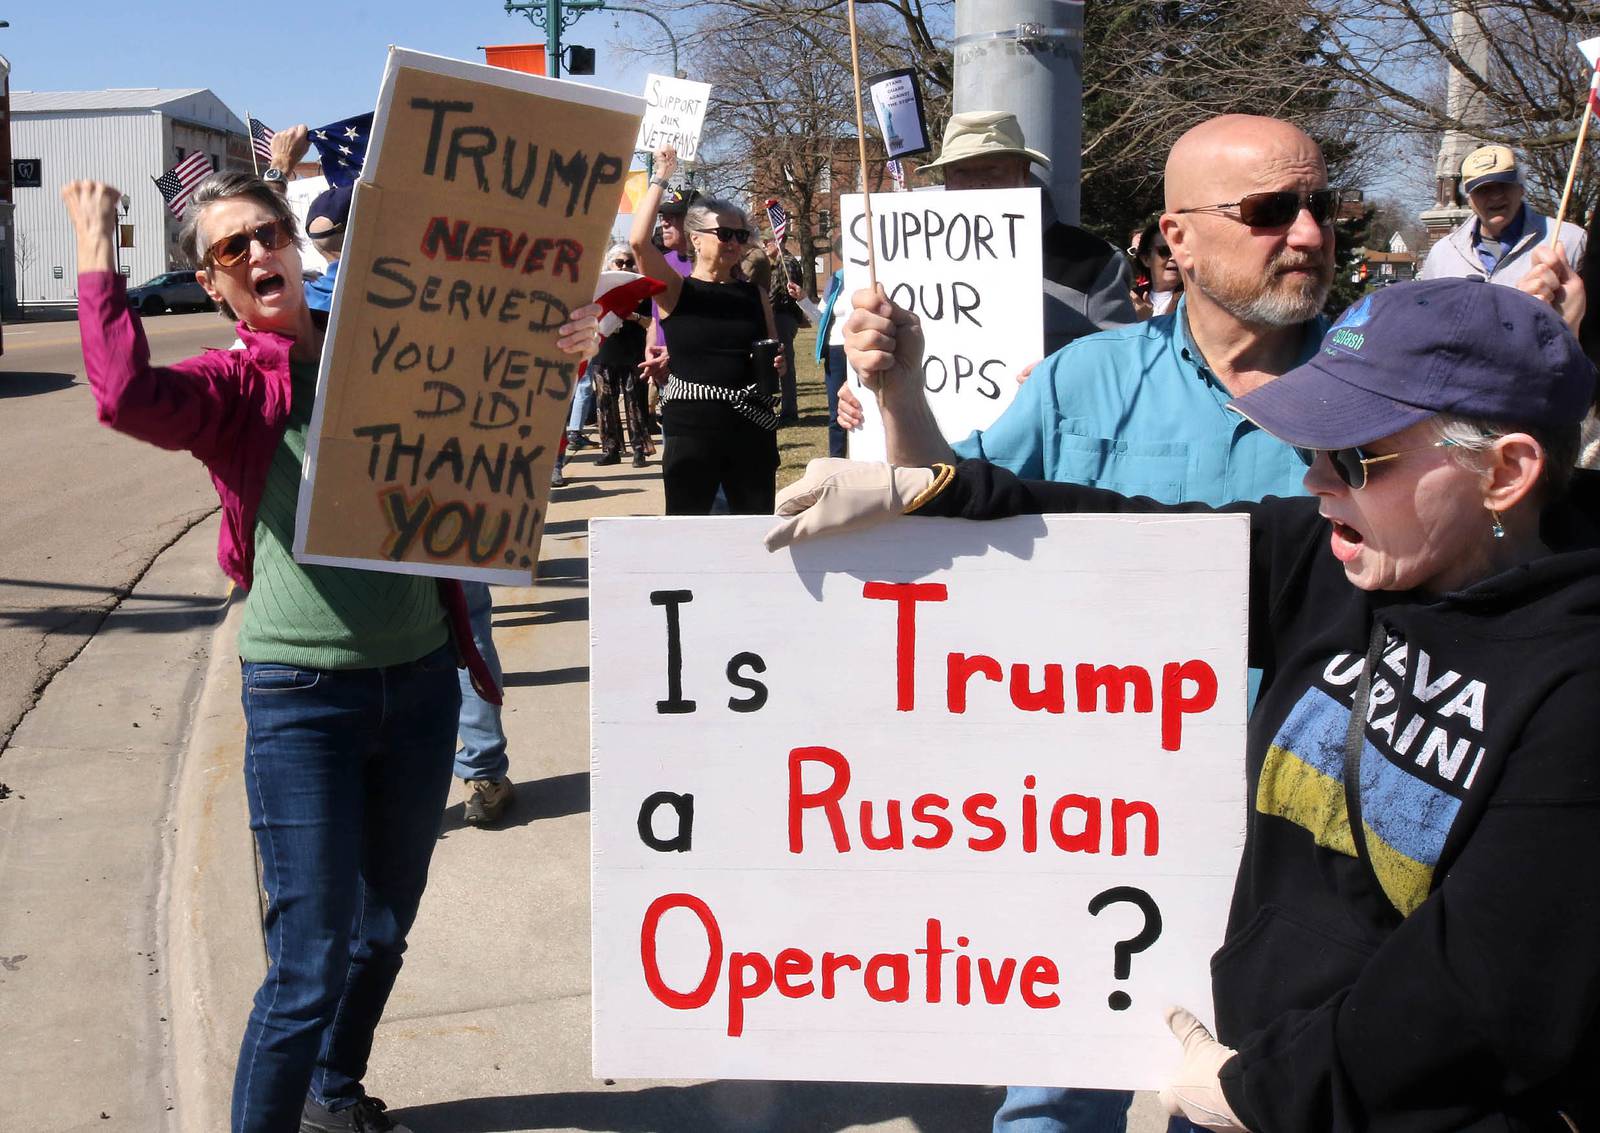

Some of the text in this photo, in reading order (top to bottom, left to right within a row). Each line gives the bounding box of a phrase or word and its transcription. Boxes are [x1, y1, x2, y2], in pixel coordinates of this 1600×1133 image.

[647, 80, 702, 116] SUPPORT
[886, 79, 902, 88] STAND
[889, 91, 910, 99] AGAINST
[410, 97, 622, 217] TRUMP
[642, 122, 697, 158] VETERANS
[420, 216, 584, 283] NEVER
[850, 209, 1025, 266] SUPPORT
[366, 256, 571, 331] SERVED
[373, 321, 576, 400] YOU VETS
[413, 380, 535, 439] DID!
[353, 423, 546, 499] THANK
[378, 487, 541, 568] YOU!!
[650, 582, 1218, 751] Is Trump
[637, 746, 1160, 857] a Russian
[641, 893, 1061, 1038] Operative
